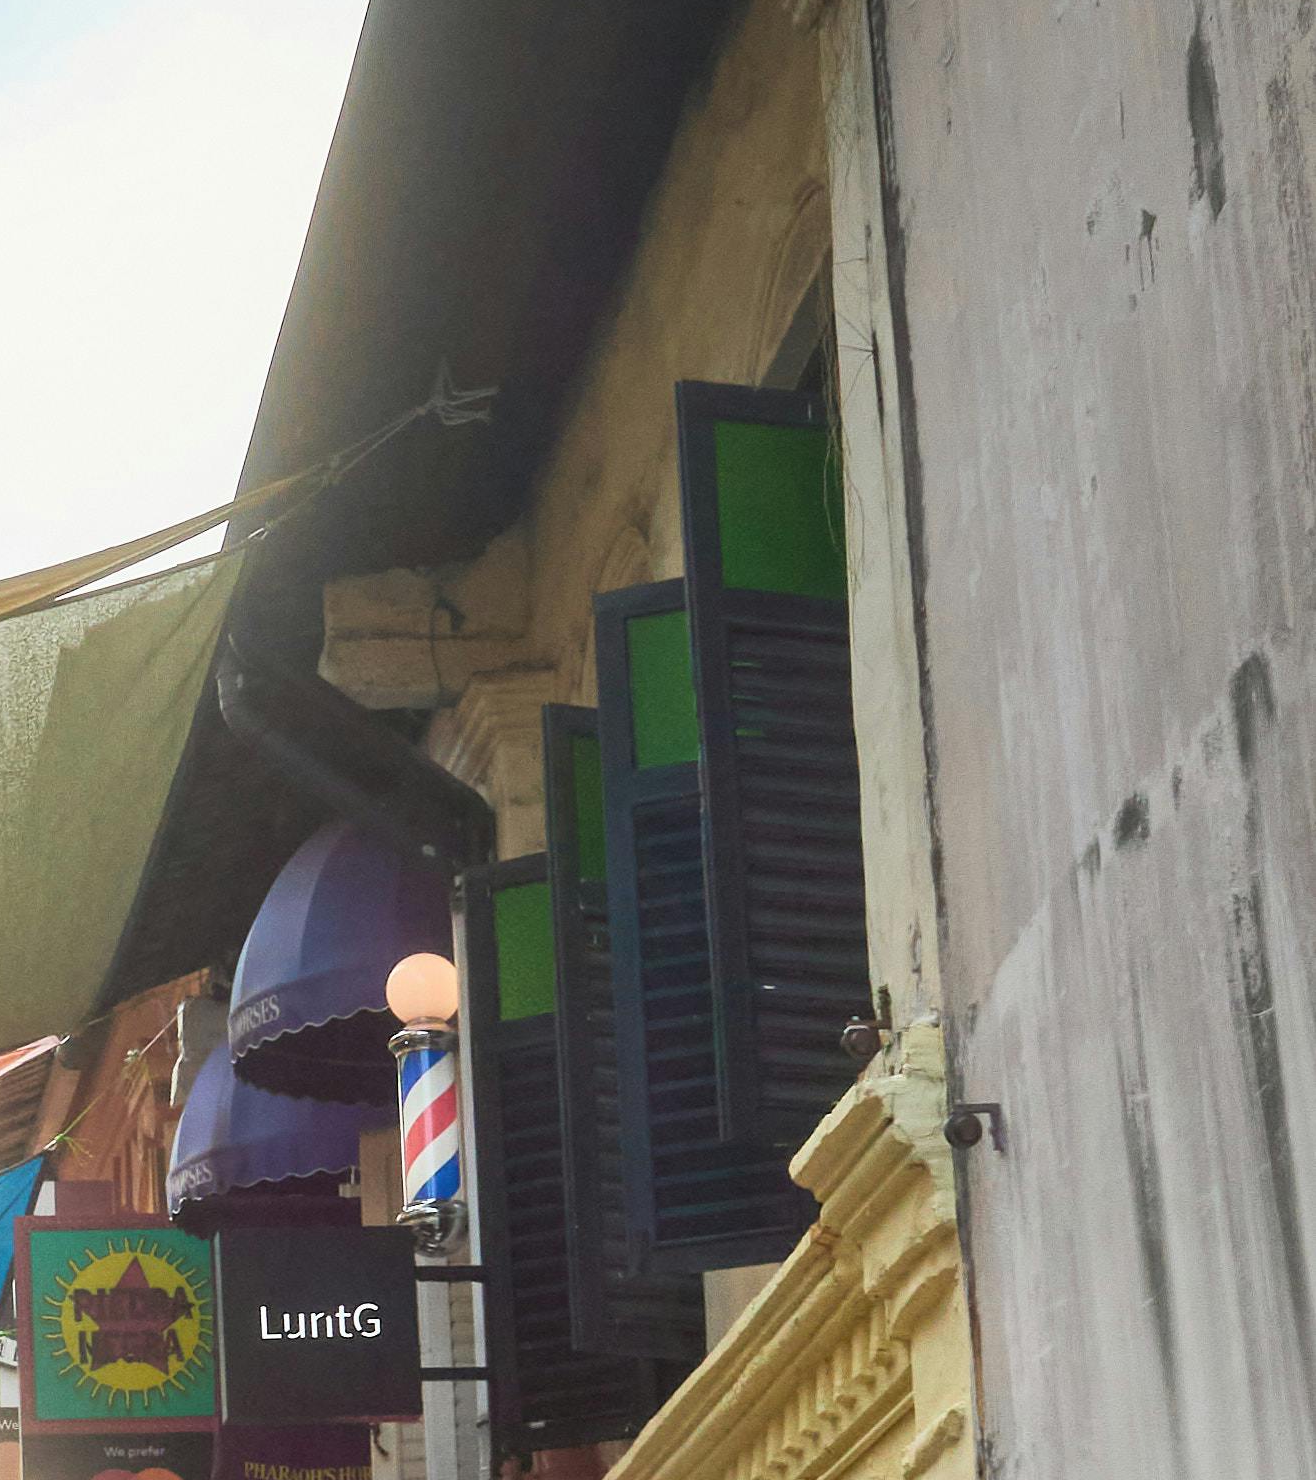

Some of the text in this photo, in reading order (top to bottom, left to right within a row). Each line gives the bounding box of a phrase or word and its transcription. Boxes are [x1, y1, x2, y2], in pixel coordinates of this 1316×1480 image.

[259, 1303, 381, 1339] LuntG
[103, 1446, 165, 1458] We prefer
